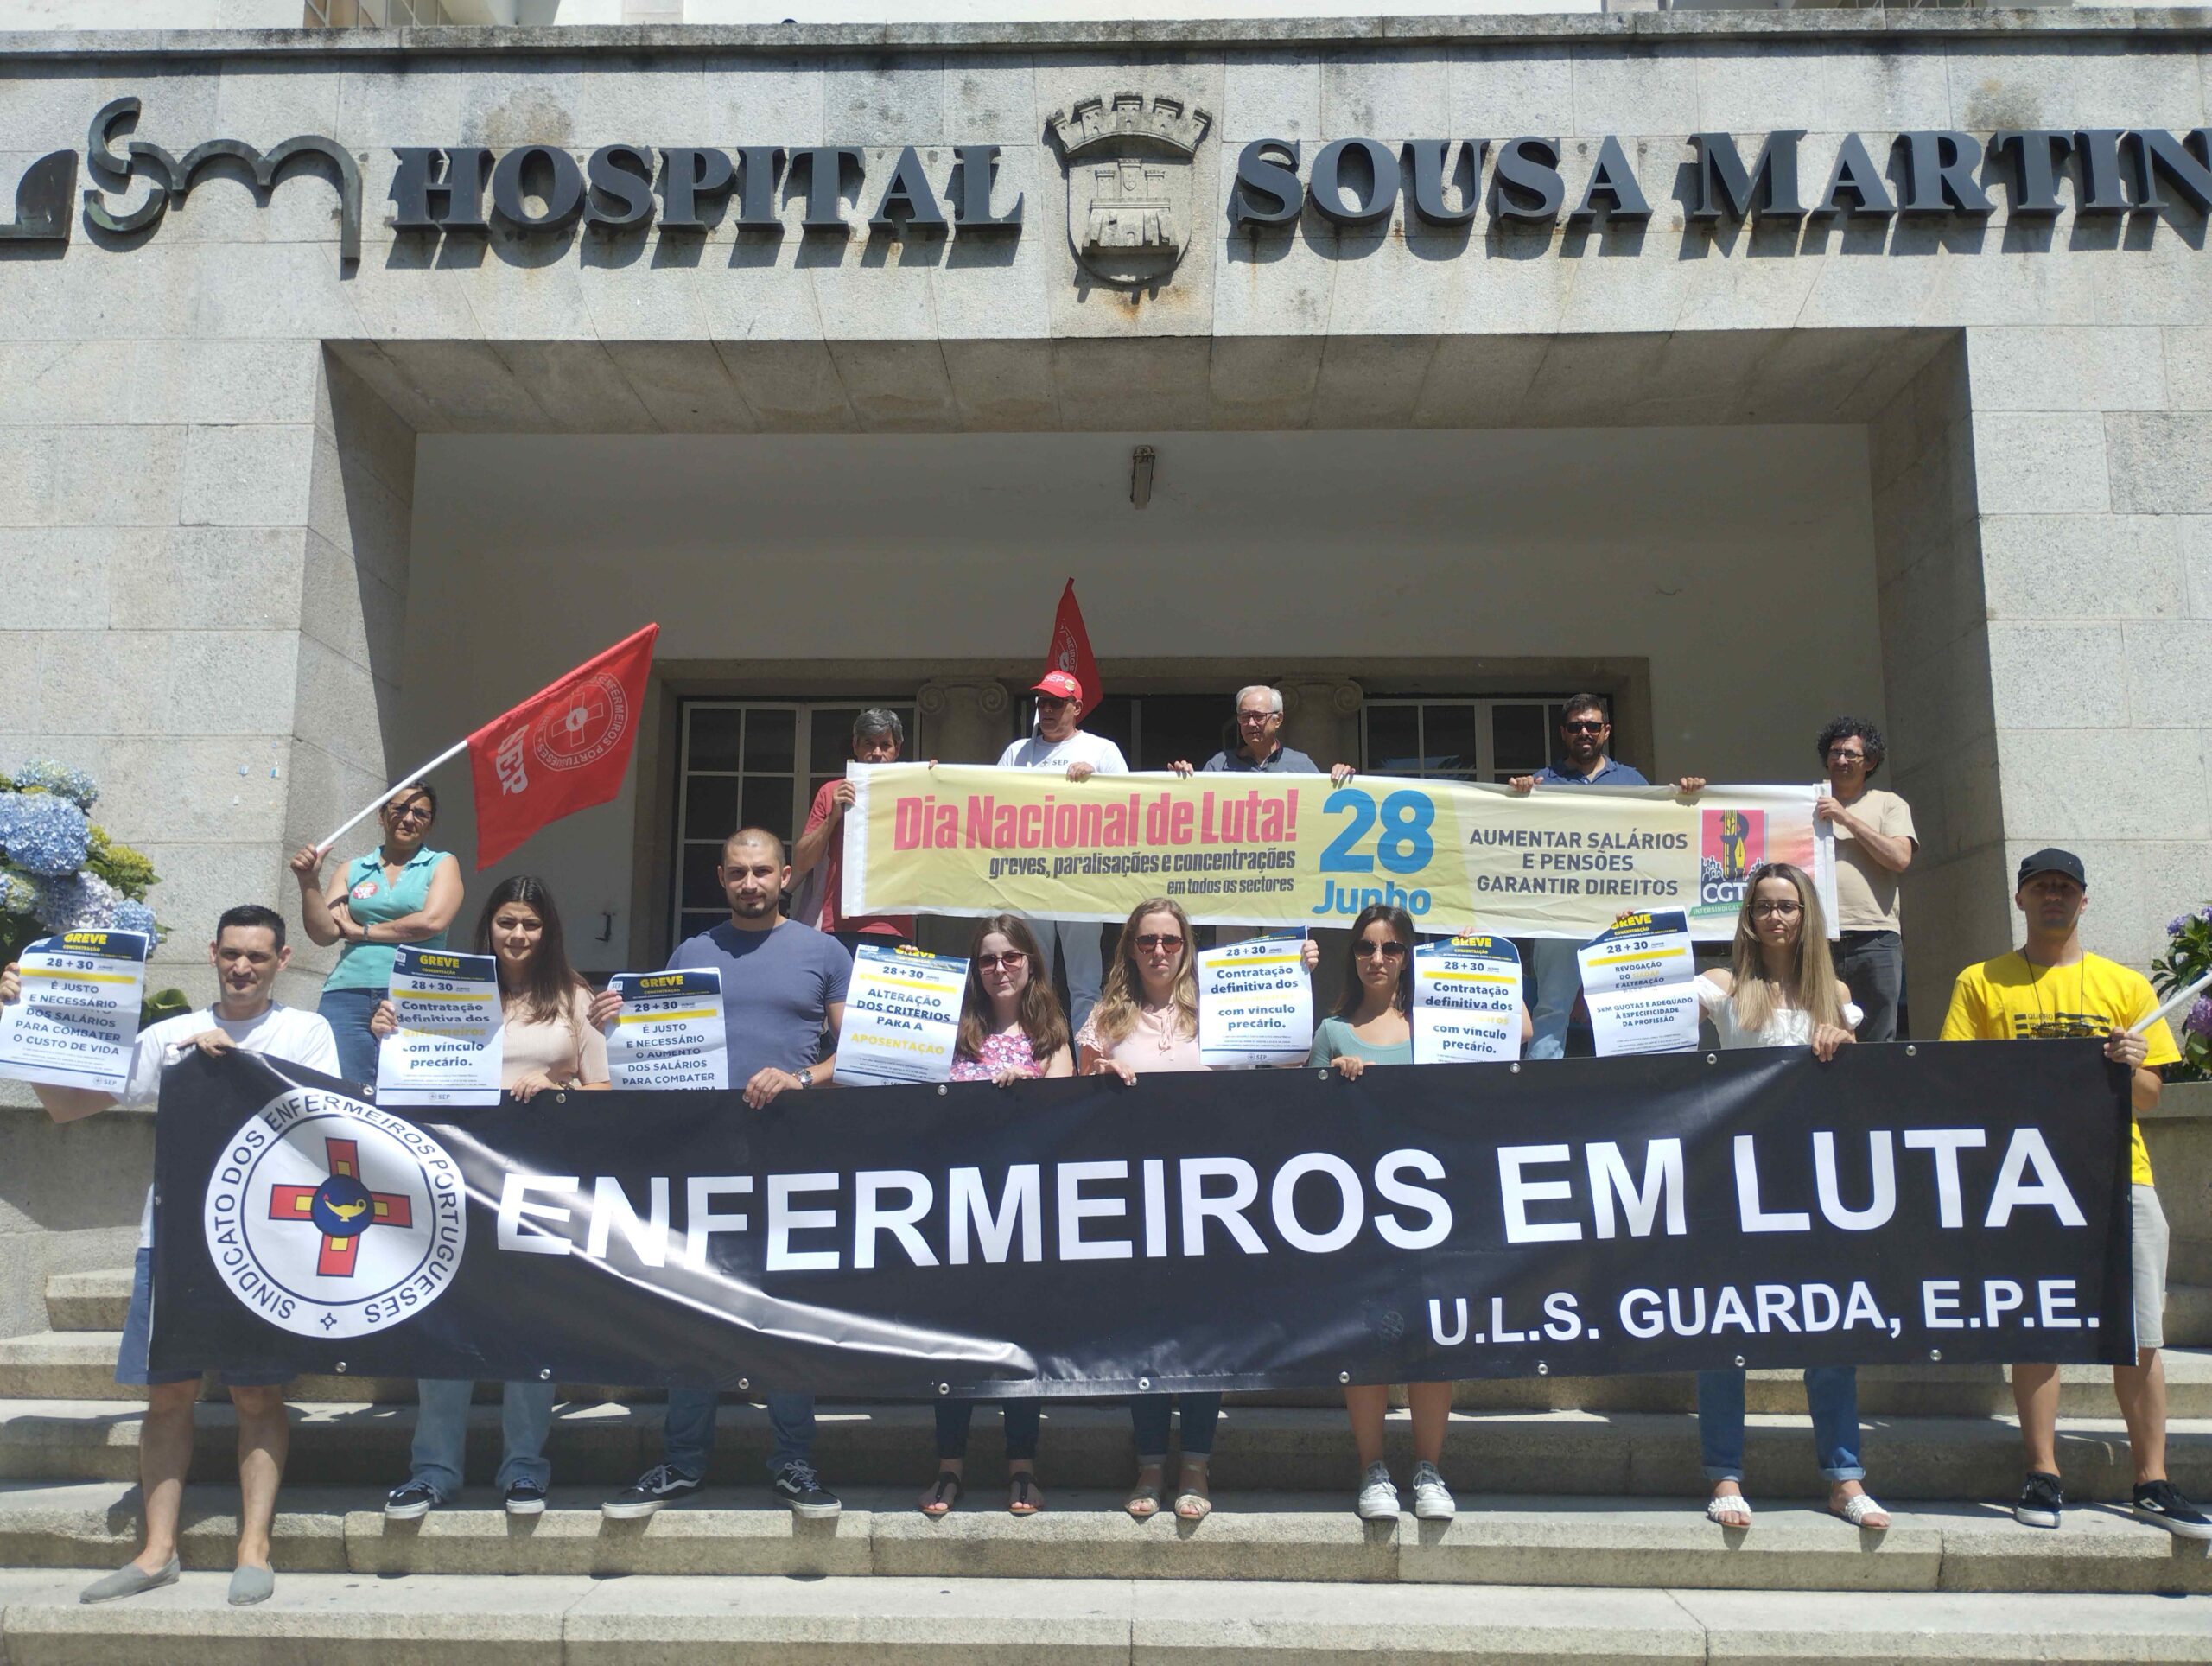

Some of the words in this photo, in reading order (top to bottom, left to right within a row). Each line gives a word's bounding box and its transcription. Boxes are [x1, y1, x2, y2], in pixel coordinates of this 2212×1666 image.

[391, 143, 1024, 234] HOSPITAL
[1236, 136, 1654, 227] SOUSA
[893, 794, 963, 851] Dia
[967, 792, 1144, 849] Nacional
[1147, 792, 1194, 846] de
[1201, 789, 1300, 844] Luta!
[1319, 788, 1435, 874] 28
[1469, 829, 1583, 849] AUMENTAR
[1586, 824, 1688, 850] SALÁRIOS
[988, 853, 1052, 880] greves,
[1053, 849, 1160, 877] paralisações
[1161, 856, 1172, 874] e
[1173, 847, 1295, 874] concentrações
[1522, 854, 1535, 870] E
[1540, 848, 1634, 872] PENSÕES
[1166, 881, 1186, 895] em
[1187, 879, 1222, 894] todos
[1223, 881, 1237, 893] os
[1238, 877, 1294, 893] sectores
[1476, 875, 1582, 896] GARANTIR
[1586, 877, 1679, 897] DIREITOS
[1312, 879, 1432, 916] Junho
[63, 932, 108, 945] GREVE
[1450, 937, 1492, 948] GREVE
[1225, 948, 1240, 957] 28
[1251, 945, 1266, 954] 30
[1606, 944, 1622, 954] 28
[1633, 941, 1649, 950] 30
[46, 957, 63, 968] 28
[76, 959, 94, 970] 30
[419, 954, 461, 968] GREVE
[1444, 961, 1459, 970] 28
[1470, 962, 1484, 971] 30
[1615, 961, 1662, 972] REVOGAÇÃO
[882, 965, 898, 975] 28
[908, 970, 924, 979] 30
[1217, 966, 1294, 979] Contratação
[51, 980, 59, 990] É
[61, 983, 99, 994] JUSTO
[411, 980, 427, 990] 28
[437, 982, 454, 992] 30
[639, 975, 684, 989] GREVE
[1211, 982, 1273, 995] definitiva
[1275, 979, 1299, 989] dos
[1621, 977, 1665, 989] ALTERAÇÃO
[1433, 982, 1510, 998] Contratação
[29, 994, 37, 1002] E
[40, 994, 118, 1008] NECESSÁRIO
[868, 988, 942, 1008] ALTERAÇÃO
[1425, 995, 1488, 1010] definitiva
[1491, 1000, 1513, 1011] dos
[1613, 1002, 1644, 1011] QUOTAS
[1651, 997, 1694, 1007] ADEQUADO
[401, 1000, 484, 1014] Contratação
[634, 1002, 651, 1013] 28
[662, 1001, 678, 1010] 30
[856, 1000, 884, 1012] DOS
[886, 1004, 951, 1022] CRITÉRIOS
[1218, 1008, 1244, 1016] com
[1248, 1004, 1295, 1015] vínculo
[1622, 1008, 1680, 1019] ESPECIFICIDADE
[26, 1008, 52, 1020] DOS
[54, 1010, 117, 1028] SALÁRIOS
[397, 1014, 462, 1023] definitiva
[465, 1014, 491, 1023] dos
[876, 1016, 911, 1030] PARA
[913, 1022, 923, 1031] A
[1228, 1018, 1287, 1031] precário.
[1634, 1015, 1675, 1026] PROFISSÃO
[16, 1021, 48, 1033] PARA
[53, 1026, 121, 1042] COMBATER
[643, 1024, 650, 1033] É
[652, 1023, 687, 1033] JUSTO
[1433, 1024, 1459, 1034] com
[1462, 1027, 1507, 1040] vínculo
[13, 1033, 22, 1042] O
[25, 1036, 67, 1049] CUSTO
[71, 1042, 87, 1052] DE
[90, 1045, 120, 1055] VIDA
[435, 1041, 485, 1052] vínculo
[626, 1040, 633, 1049] E
[636, 1034, 705, 1048] NECESSÁRIO
[850, 1033, 945, 1056] APOSENTAÇÃO
[1443, 1040, 1497, 1054] precário.
[647, 1048, 701, 1059] AUMENTO
[410, 1056, 474, 1070] precário.
[628, 1064, 651, 1072] DOS
[653, 1059, 708, 1071] SALÁRIOS
[622, 1077, 652, 1085] PARA
[654, 1072, 715, 1084] COMBATER
[264, 1094, 436, 1156] ENFERMEIROS
[221, 1129, 265, 1186] DOS
[498, 1148, 1452, 1272] ENFERMEIROS
[1497, 1138, 1688, 1243] EM
[1733, 1128, 2088, 1233] LUTA
[364, 1159, 460, 1324] PORTUGUESES
[215, 1193, 296, 1319] SINDICATO
[1428, 1290, 1600, 1346] U.L.S.
[1619, 1281, 1901, 1339] GUARDA,
[1922, 1279, 2100, 1329] E.P.E.
